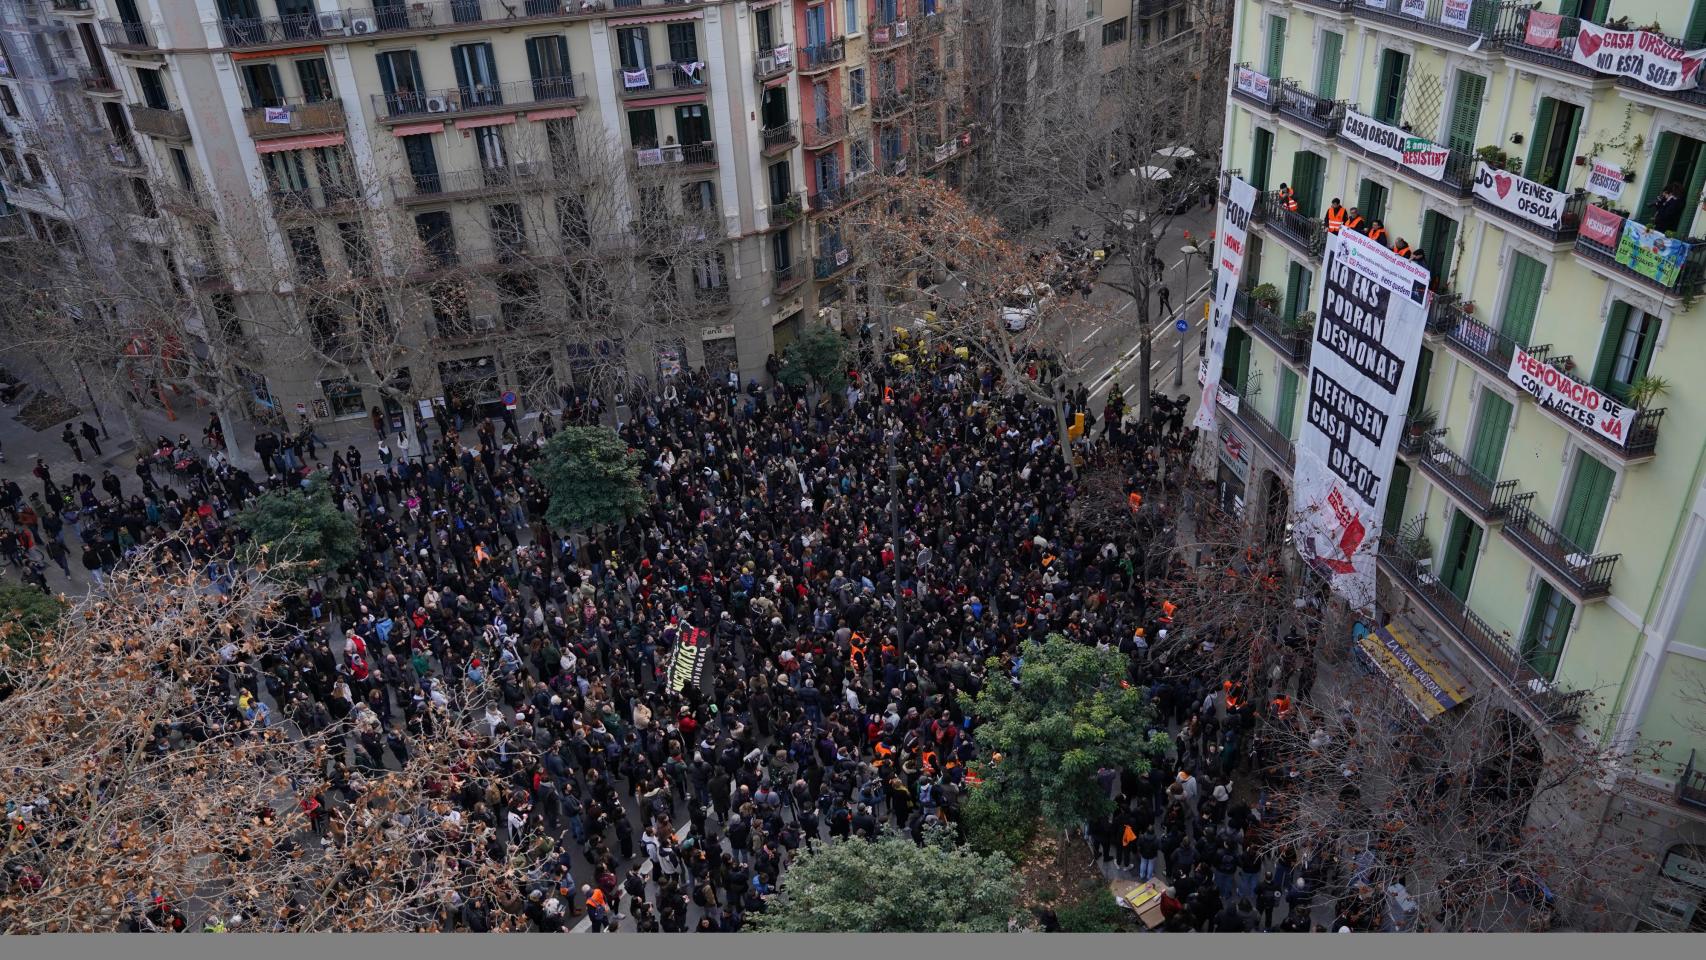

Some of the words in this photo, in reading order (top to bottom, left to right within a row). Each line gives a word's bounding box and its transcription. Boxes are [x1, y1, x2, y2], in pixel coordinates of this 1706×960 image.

[1603, 32, 1634, 49] CASA
[1638, 31, 1685, 62] ORSOLA
[1597, 53, 1612, 69] NO
[1617, 54, 1644, 75] ESTÀ
[1646, 63, 1677, 86] SOLA
[1346, 116, 1368, 140] CASA
[1368, 126, 1405, 154] ORSOLA
[1406, 141, 1411, 149] 2
[1403, 151, 1447, 166] RESISTINT
[1476, 168, 1493, 188] JO
[1330, 258, 1348, 288] NO
[1352, 271, 1380, 308] ENS
[1326, 288, 1383, 342] PODRAN
[1322, 317, 1398, 385] DESNONAR
[1312, 400, 1345, 443] CASA
[1315, 373, 1383, 439] DEFENSEN
[1602, 399, 1622, 418] DE
[1601, 417, 1622, 440] JA
